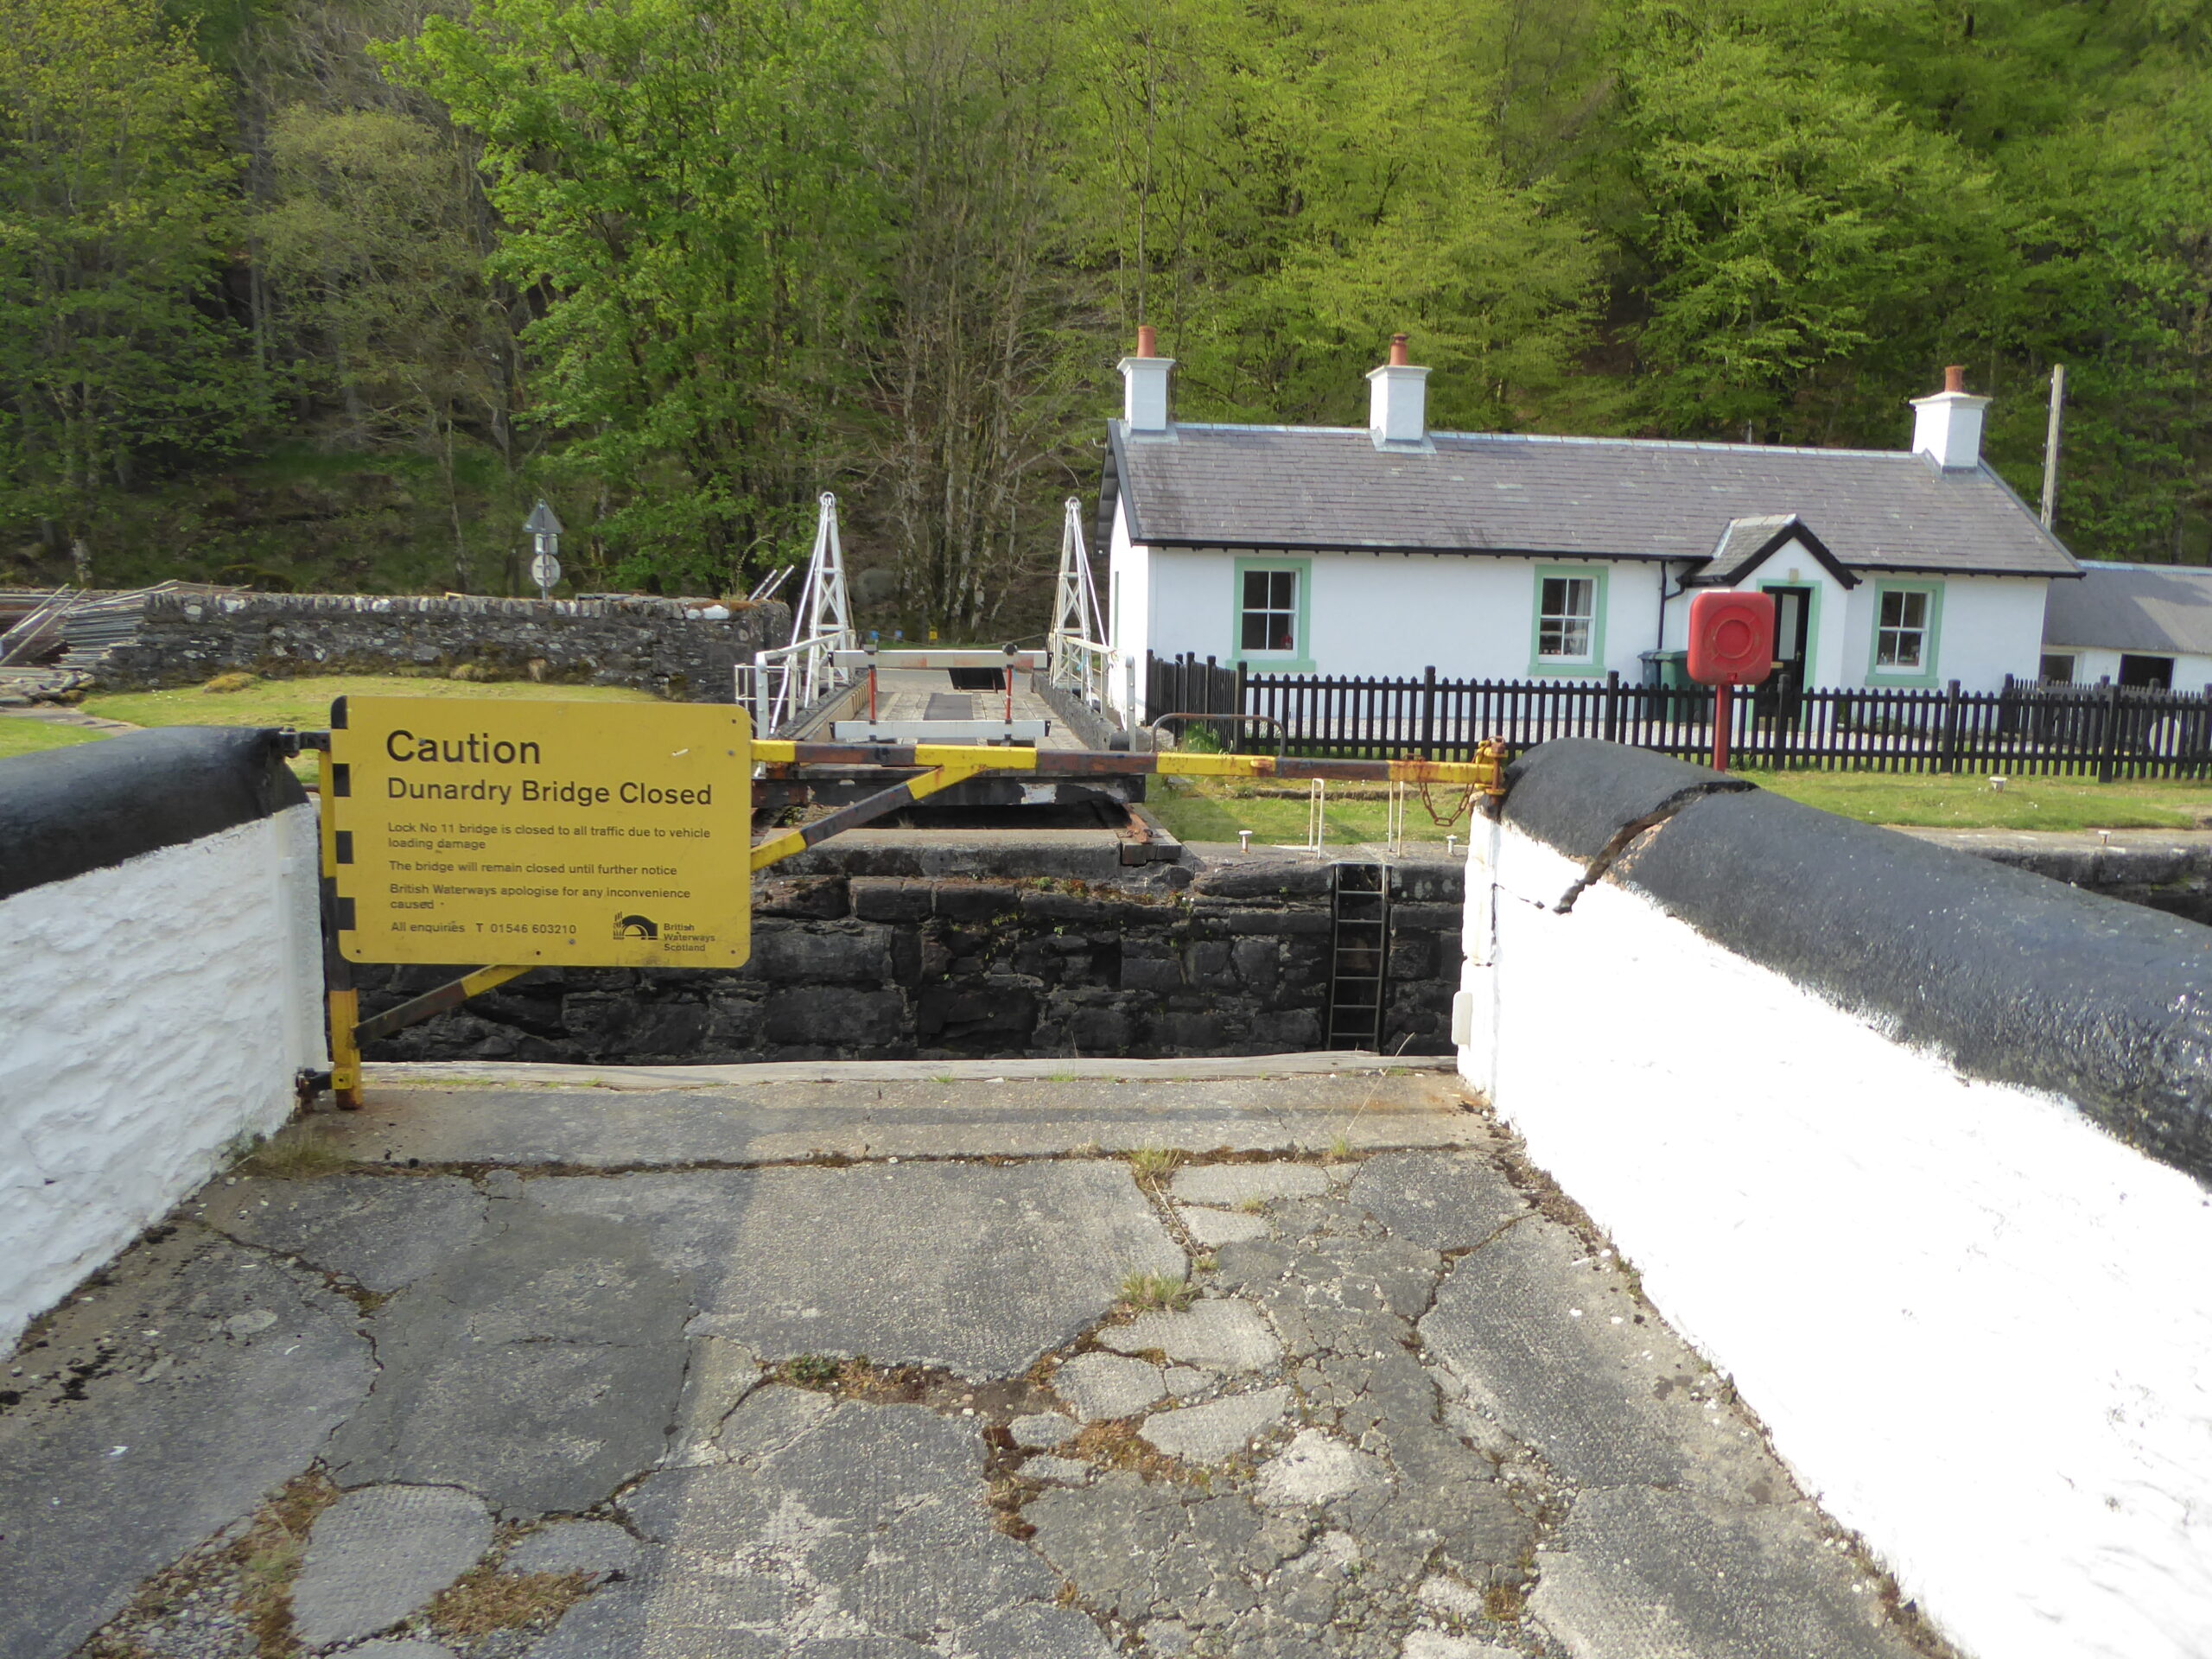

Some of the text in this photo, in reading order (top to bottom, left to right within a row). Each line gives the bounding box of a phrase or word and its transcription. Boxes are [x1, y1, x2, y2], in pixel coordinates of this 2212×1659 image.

[386, 729, 540, 765] Caution
[388, 777, 711, 807] Dunardry Bridge Closed
[388, 822, 711, 838] Lock No 11 bridge is closed to all traffic due to vehicle
[388, 837, 486, 851] loading damage
[388, 860, 677, 875] The bridge will remain closed until further notice
[389, 883, 691, 899] British Waterways apologise for any inconvenience
[390, 899, 435, 910] caused
[391, 921, 577, 934] All enquiries T 01546 603210
[663, 923, 695, 931] British
[663, 933, 716, 944] Waterways
[664, 943, 706, 952] Scotland
